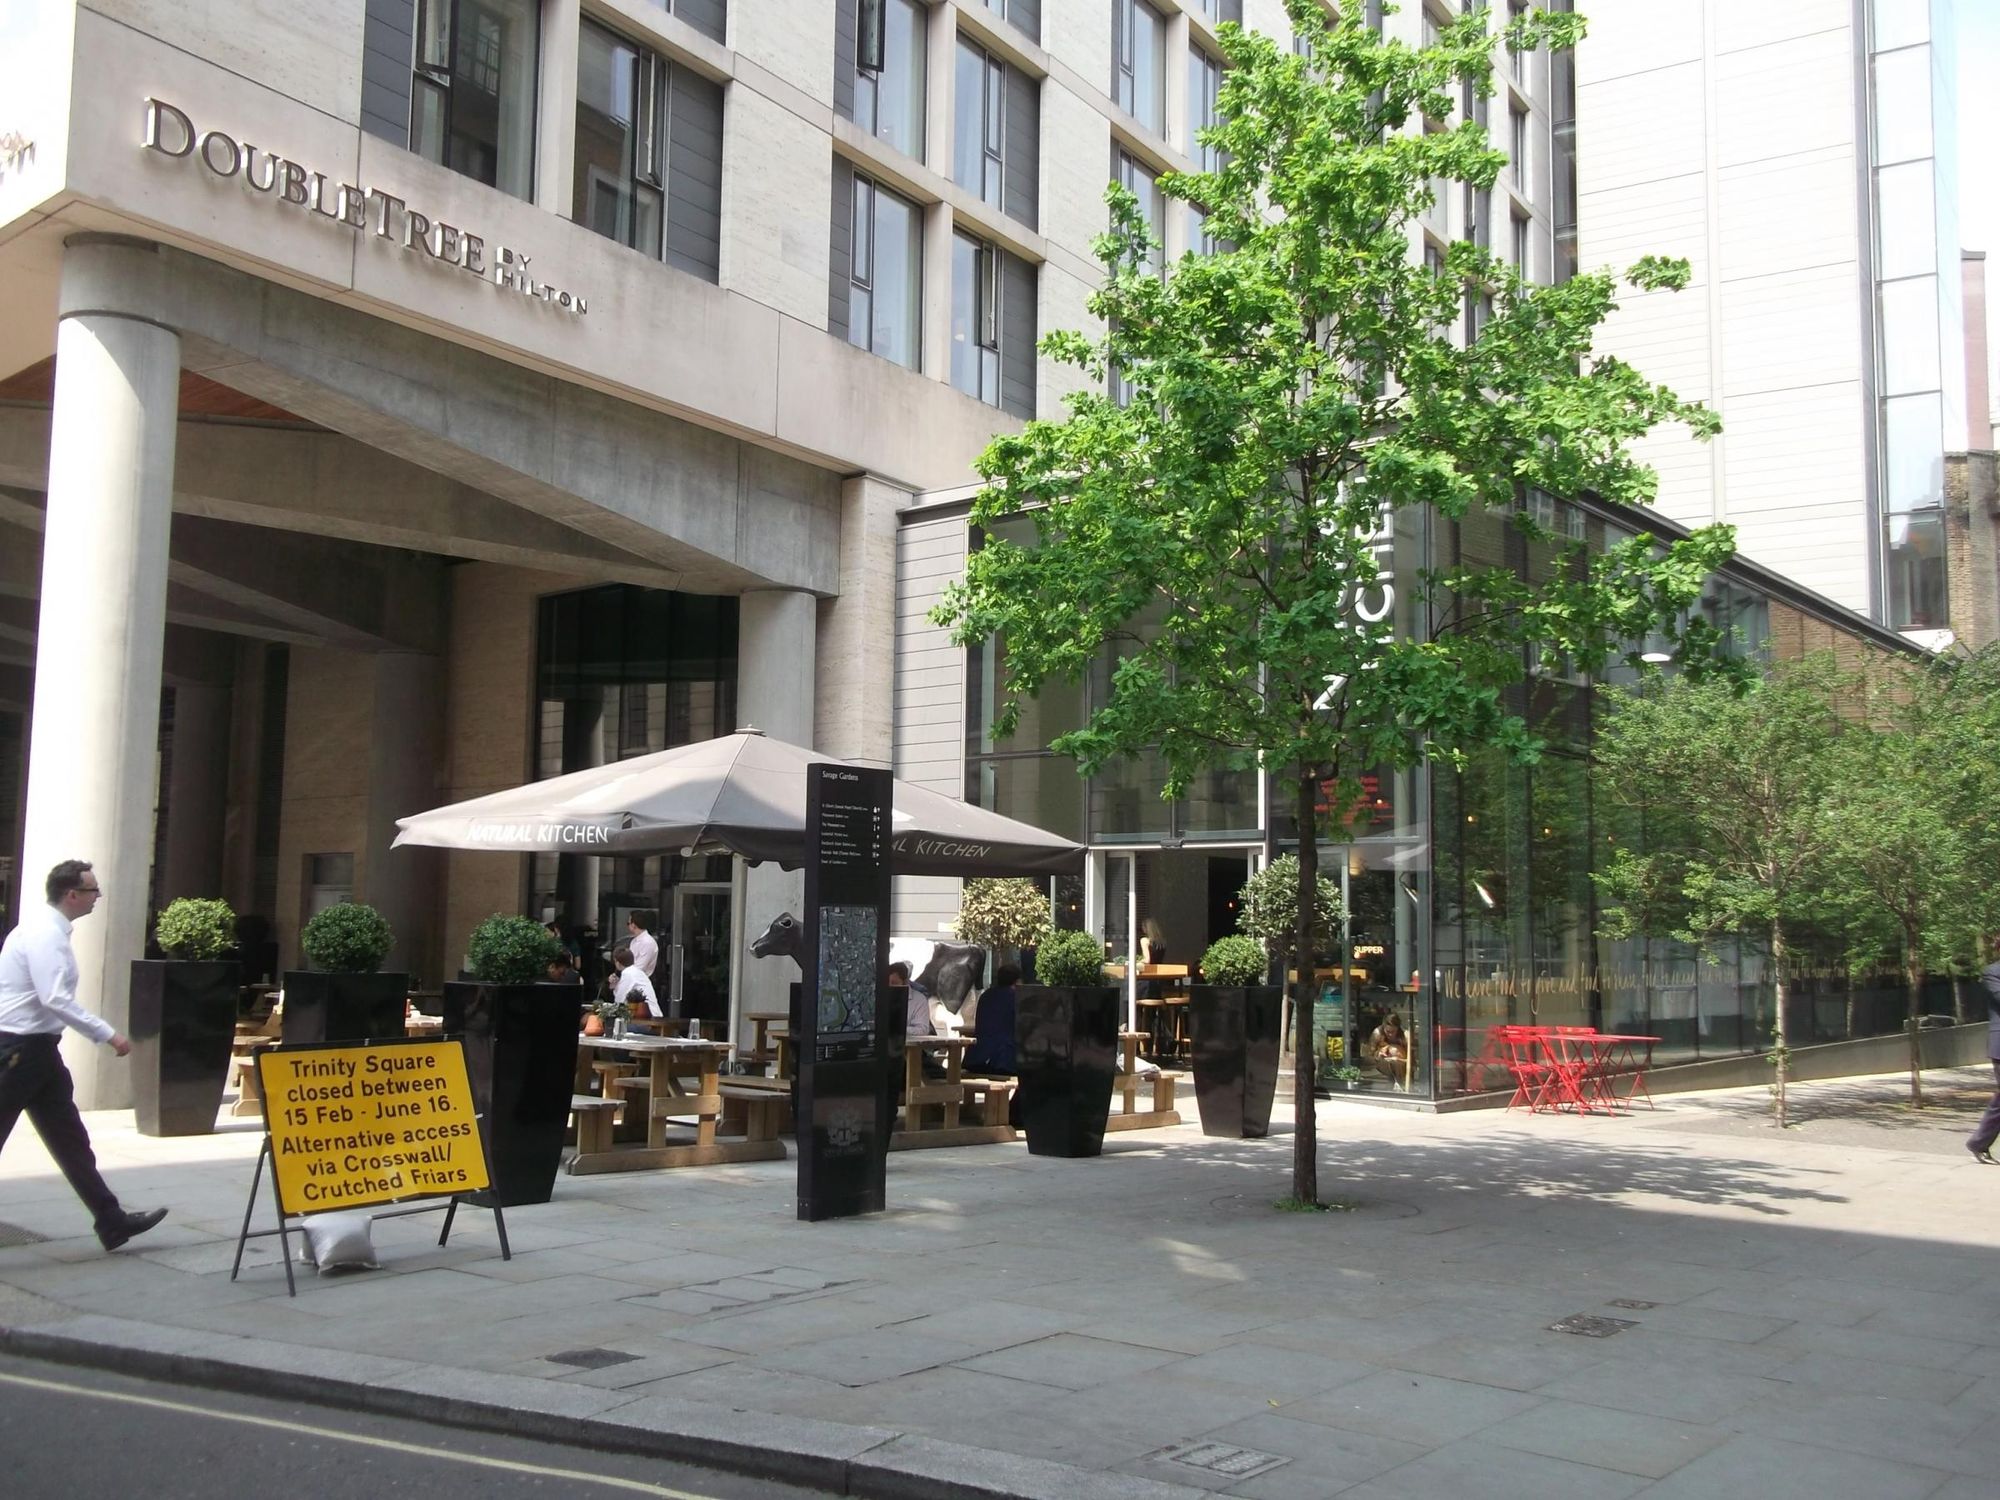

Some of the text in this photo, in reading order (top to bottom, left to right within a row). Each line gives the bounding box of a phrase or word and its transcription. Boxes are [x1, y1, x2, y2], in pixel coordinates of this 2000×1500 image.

[496, 246, 532, 271] BY
[496, 266, 588, 315] HILTON
[466, 824, 609, 844] NATURAL KITCHEN
[915, 839, 991, 858] KITCHEN
[1354, 945, 1384, 954] SUPPER
[1445, 968, 1460, 998] We
[1465, 965, 1491, 998] have
[1495, 964, 1517, 1014] food
[1531, 970, 1556, 1015] give
[1559, 966, 1577, 994] and
[290, 1055, 436, 1078] Trinity Square
[287, 1076, 447, 1103] closed between
[284, 1108, 308, 1126] 15
[316, 1104, 353, 1124] Feb
[375, 1101, 421, 1120] June
[428, 1095, 458, 1114] 16.
[282, 1122, 471, 1155] Alternative access
[306, 1142, 452, 1177] via Crosswall/
[303, 1167, 468, 1201] Crutched Friars
